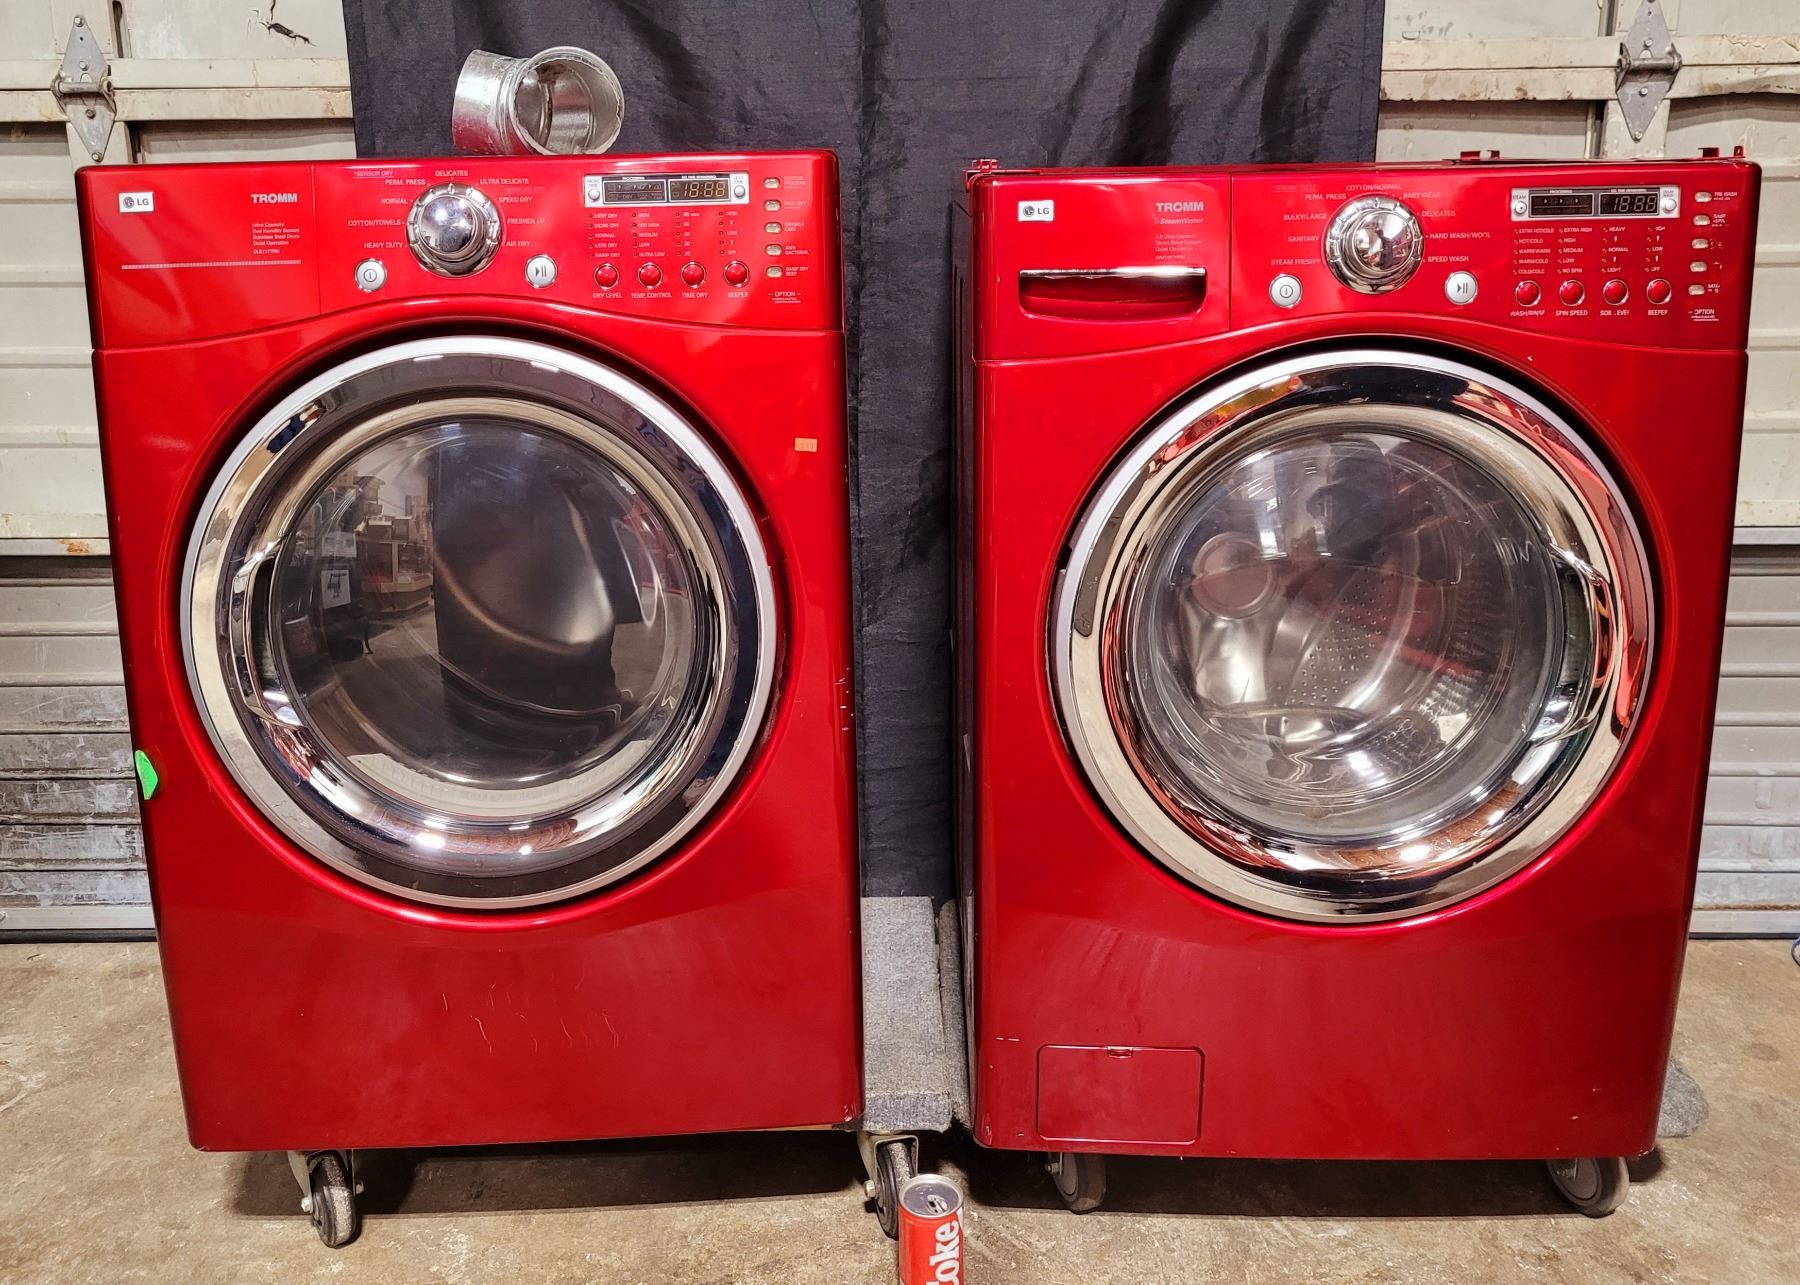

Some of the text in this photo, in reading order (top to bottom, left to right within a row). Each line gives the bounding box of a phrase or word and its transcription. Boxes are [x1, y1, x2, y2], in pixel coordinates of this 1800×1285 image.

[251, 193, 297, 204] TROMM
[1614, 196, 1657, 211] 18:88
[1155, 202, 1204, 212] TROMM
[926, 1220, 960, 1285] oke
